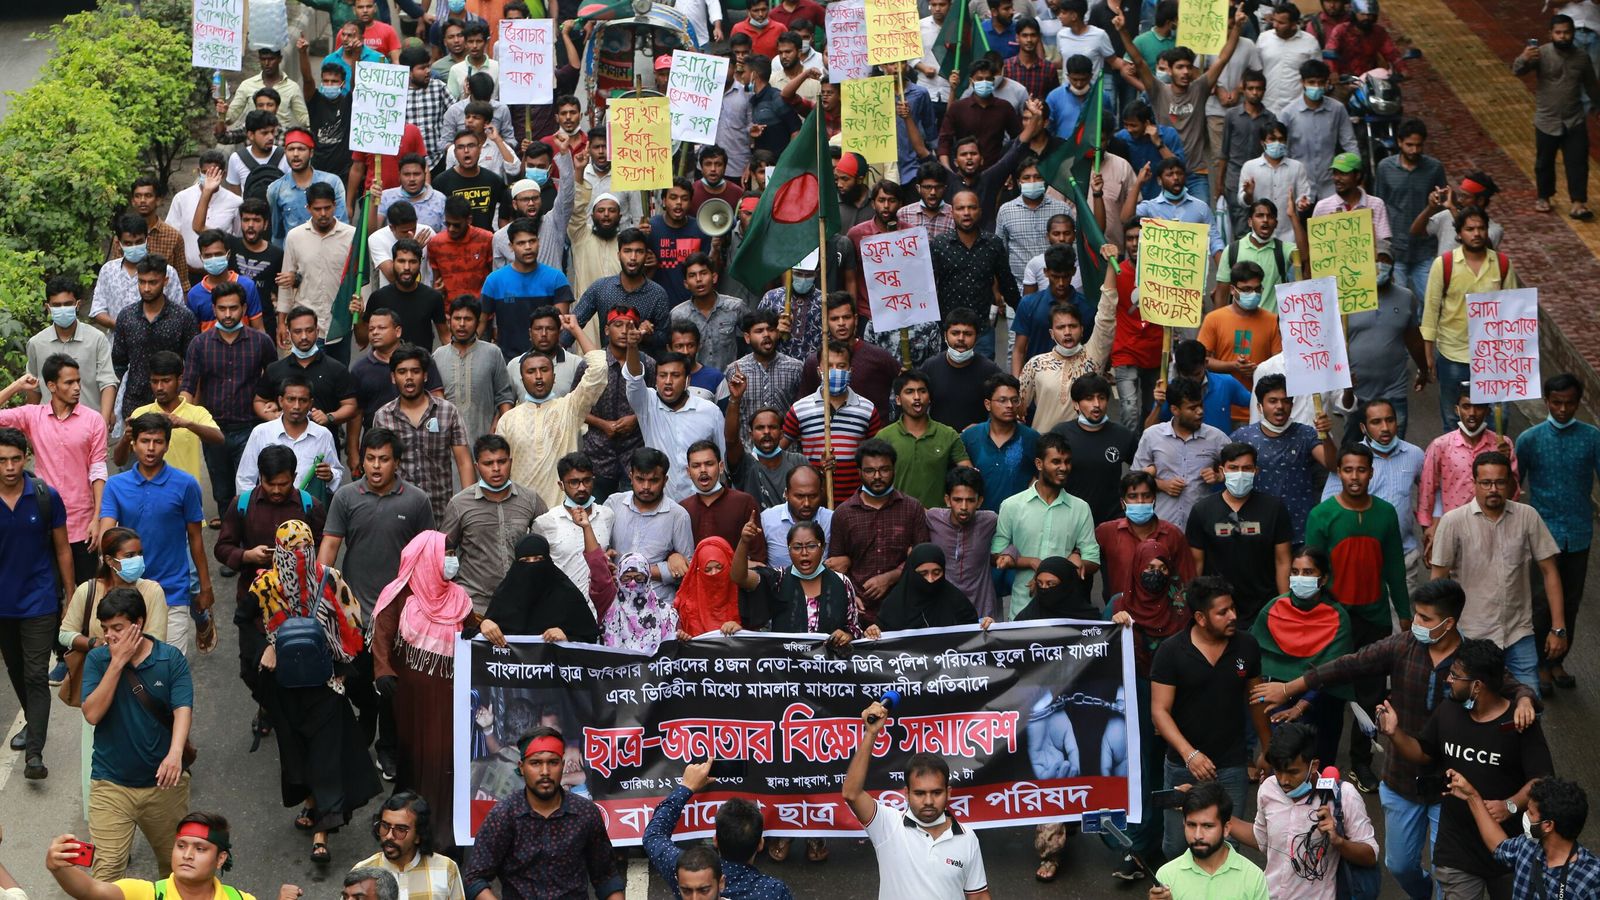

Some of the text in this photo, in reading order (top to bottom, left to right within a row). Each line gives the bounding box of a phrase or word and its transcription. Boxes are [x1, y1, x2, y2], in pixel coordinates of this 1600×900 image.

[509, 45, 544, 66] নিপাত
[355, 83, 403, 107] নিপাত
[874, 270, 901, 287] বন্ধ
[1469, 302, 1501, 319] সাদা
[1288, 313, 1321, 347] মুক্তি
[1484, 318, 1537, 338] পোশাকে
[1472, 352, 1536, 374] সংবিধান
[486, 661, 555, 680] বাংলাদেশ
[558, 665, 583, 682] ছাত্র
[588, 662, 642, 680] অধিকার
[648, 656, 709, 677] পরিষদের
[715, 658, 751, 674] ৪জন
[851, 655, 884, 674] ডিবি
[888, 652, 928, 675] পুলিশ
[934, 648, 988, 669] পরিচয়ে
[991, 648, 1025, 668] তুলে
[1029, 643, 1064, 662] নিয়ে
[1067, 641, 1109, 660] যাওয়া
[606, 688, 638, 705] এবং
[641, 677, 698, 703] ভিত্তিহীন
[701, 678, 742, 698] মিথ্যে
[745, 681, 800, 698] মামলার
[805, 681, 856, 697] মাধ্যমে
[926, 673, 990, 696] প্রতিবাদে
[583, 702, 1019, 778] ছাত্র-জনতার বিক্ষোভ সমাবেশ
[1444, 742, 1501, 765] NICCE
[658, 778, 672, 789] ১২
[963, 766, 974, 780] টা
[773, 800, 838, 827] ছাত্র
[985, 781, 1093, 814] পরিষদ
